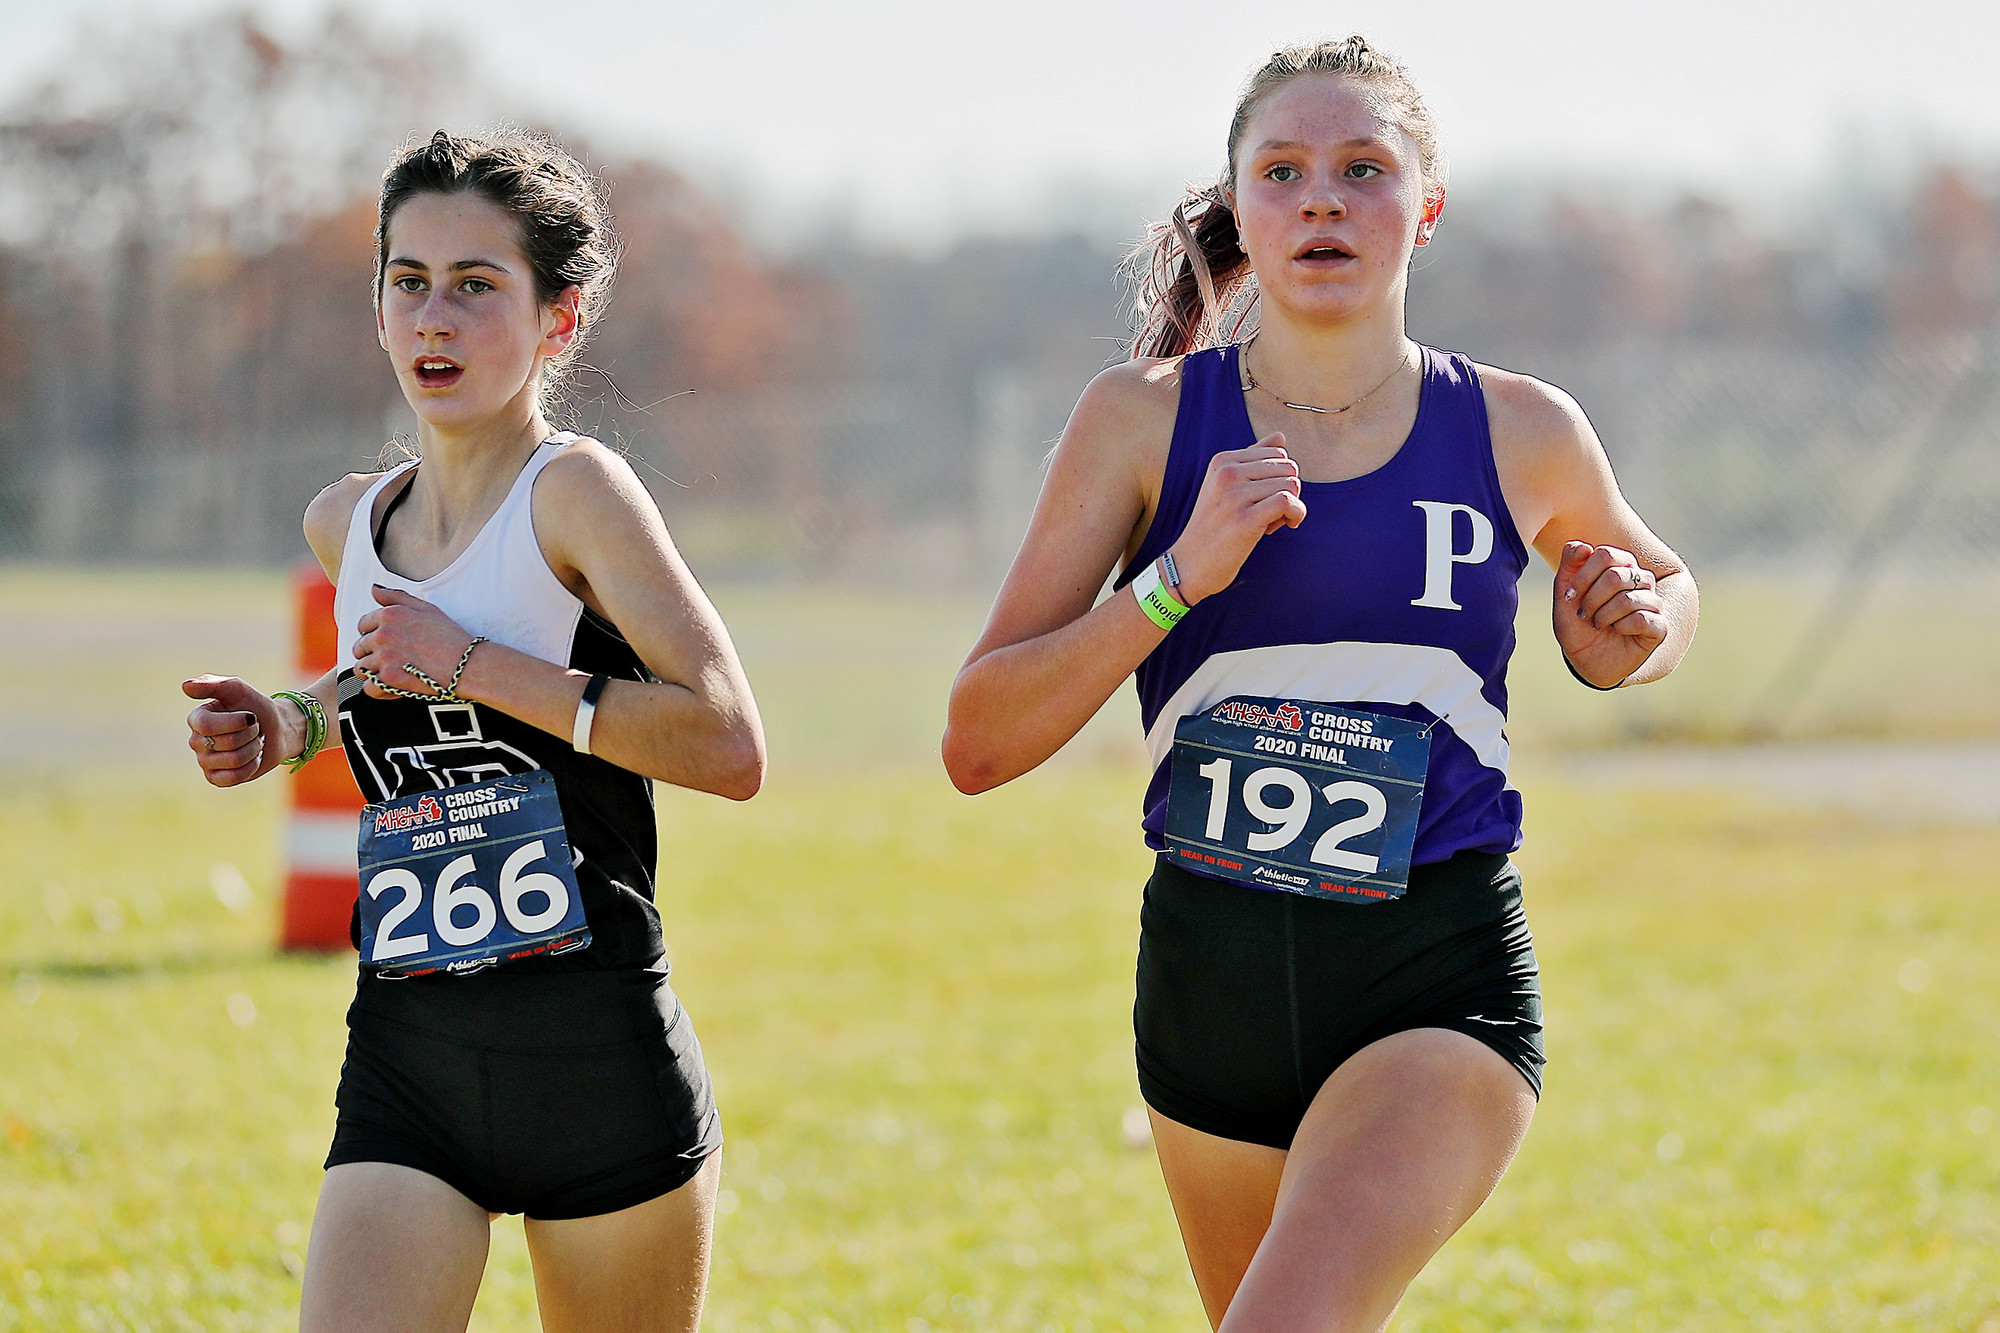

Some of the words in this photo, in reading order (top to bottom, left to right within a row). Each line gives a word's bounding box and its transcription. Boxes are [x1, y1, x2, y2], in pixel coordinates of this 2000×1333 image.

[1410, 500, 1494, 611] P
[1212, 702, 1300, 731] MHSAA
[1311, 711, 1374, 734] CROSS
[1253, 735, 1297, 756] 2020
[1300, 742, 1348, 765] FINAL
[1308, 726, 1394, 753] COUNTRY
[445, 787, 497, 808] CROSS
[448, 796, 520, 823] COUNTRY
[374, 800, 439, 833] MHSAA
[1199, 757, 1387, 874] 192
[411, 830, 446, 852] 2020
[448, 822, 488, 844] FINAL
[1180, 849, 1203, 861] WEAR
[1204, 855, 1216, 865] ON
[1217, 857, 1244, 871] FRONT
[366, 840, 570, 962] 266
[1320, 881, 1345, 892] WEAR
[1346, 885, 1359, 895] ON
[1360, 887, 1389, 899] FRONT
